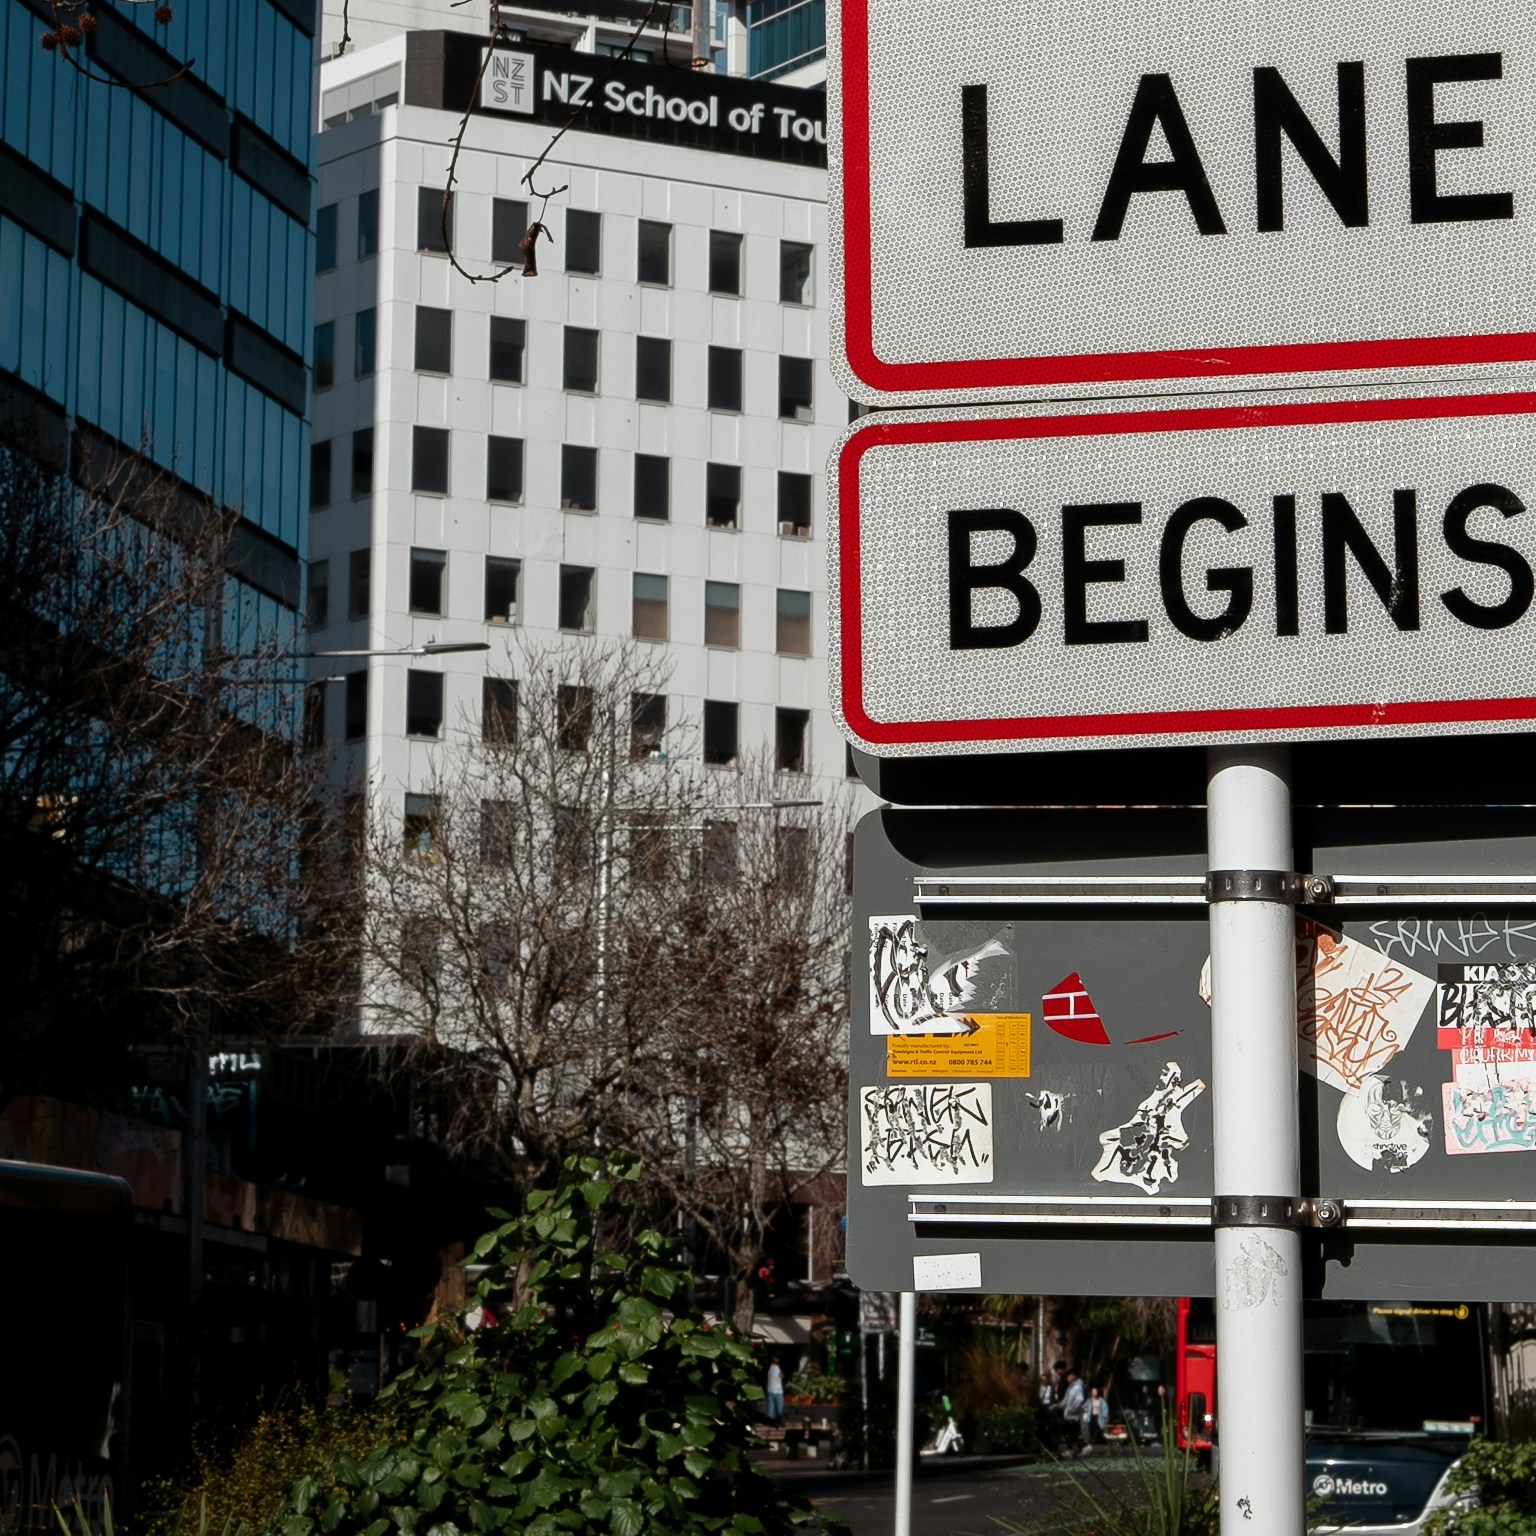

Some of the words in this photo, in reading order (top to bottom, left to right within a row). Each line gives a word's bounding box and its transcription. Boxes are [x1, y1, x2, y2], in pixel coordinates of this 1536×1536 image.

[543, 70, 594, 107] NZ
[604, 81, 718, 127] School
[729, 103, 765, 134] of
[773, 107, 827, 145] Tou
[961, 52, 1515, 249] LANE
[947, 482, 1535, 651] BEGINS
[1464, 966, 1499, 981] KIA
[1336, 1477, 1388, 1495] Metro
